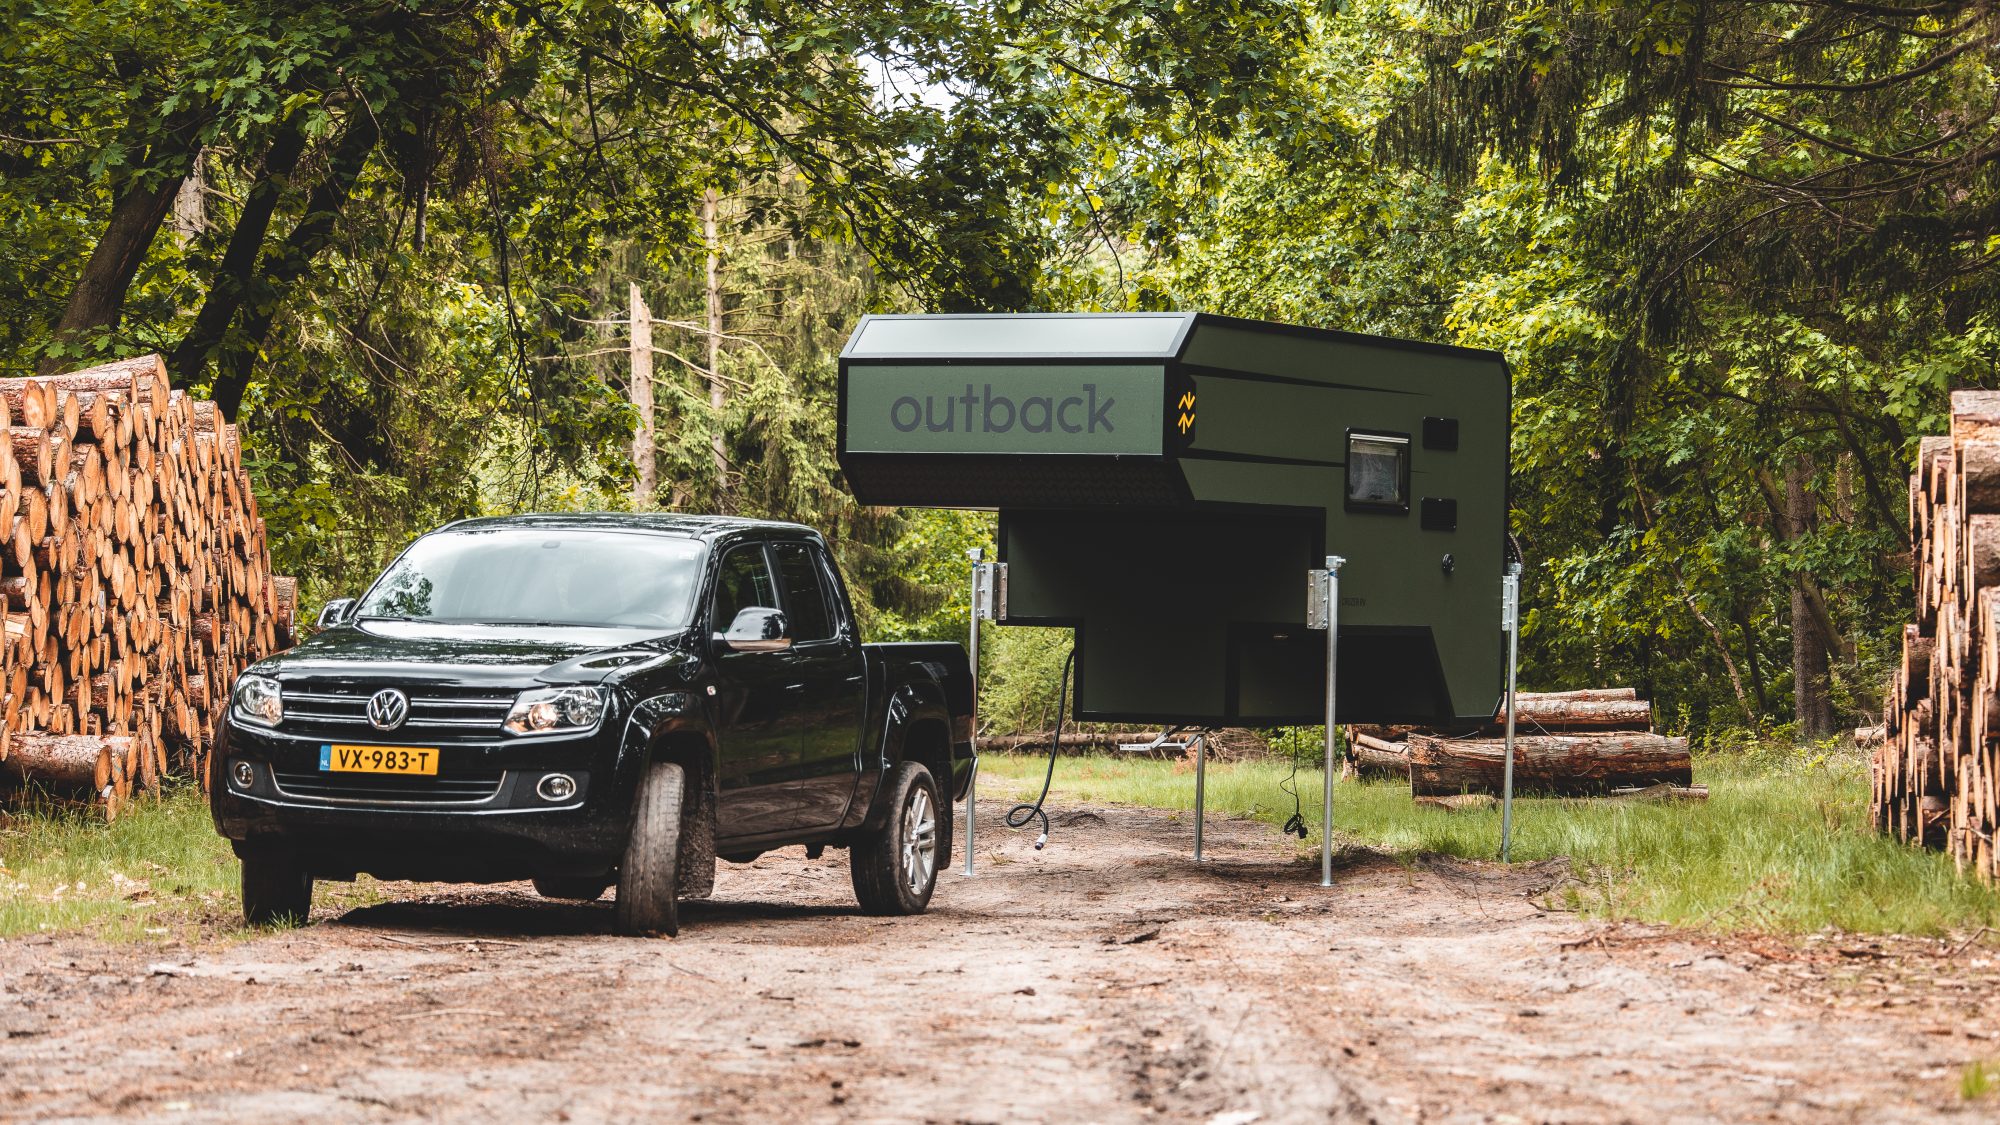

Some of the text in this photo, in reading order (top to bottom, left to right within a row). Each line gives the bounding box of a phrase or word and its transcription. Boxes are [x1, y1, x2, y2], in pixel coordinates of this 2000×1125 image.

[890, 384, 1115, 433] outback
[367, 688, 408, 730] VW
[339, 749, 429, 771] VX-983-T
